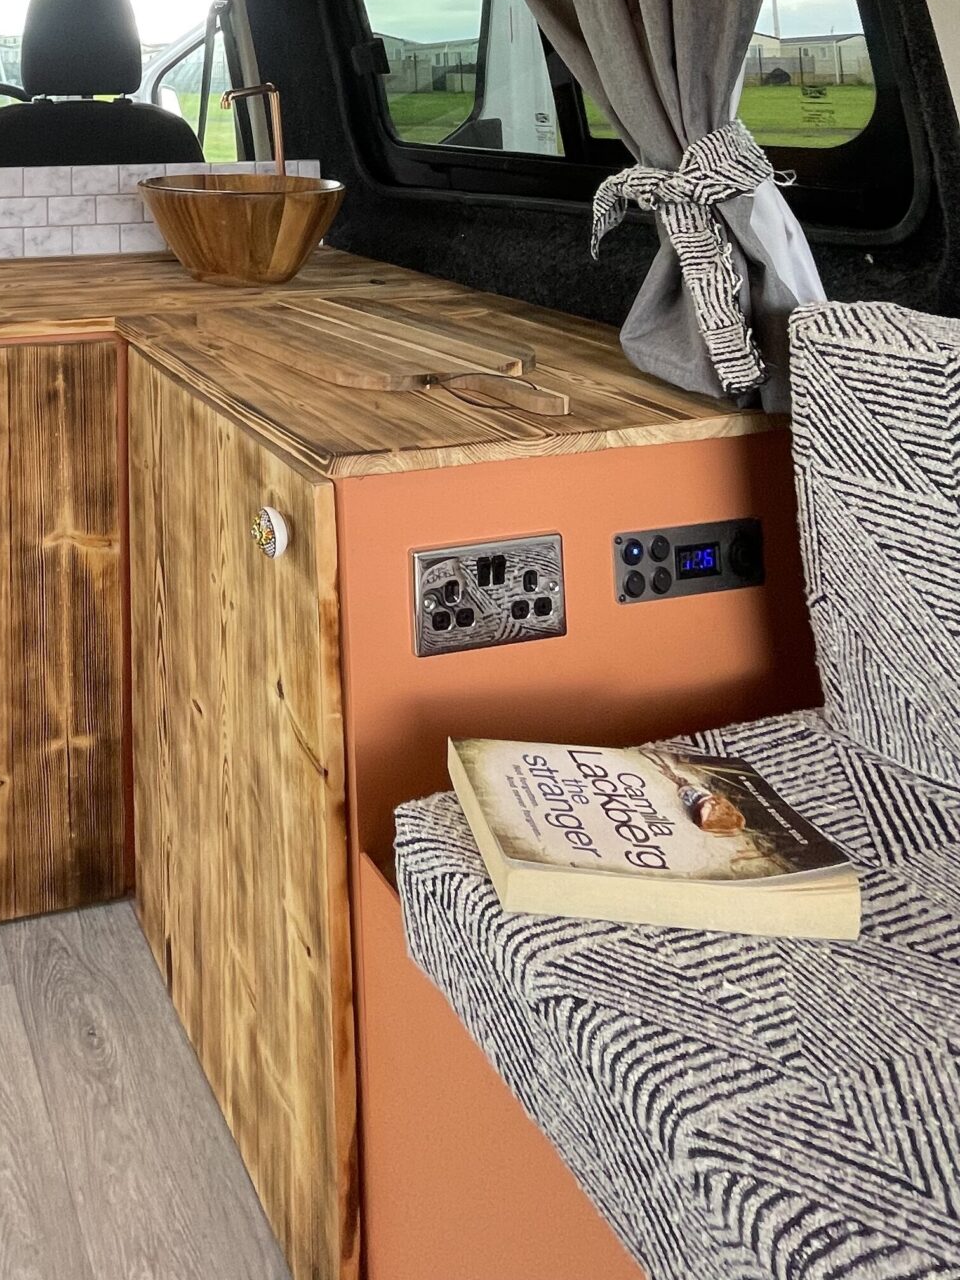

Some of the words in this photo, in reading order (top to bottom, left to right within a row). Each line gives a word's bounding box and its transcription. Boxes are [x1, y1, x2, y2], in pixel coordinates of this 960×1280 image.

[522, 753, 602, 858] stranger
[561, 777, 590, 805] the
[567, 749, 671, 870] Lackberg
